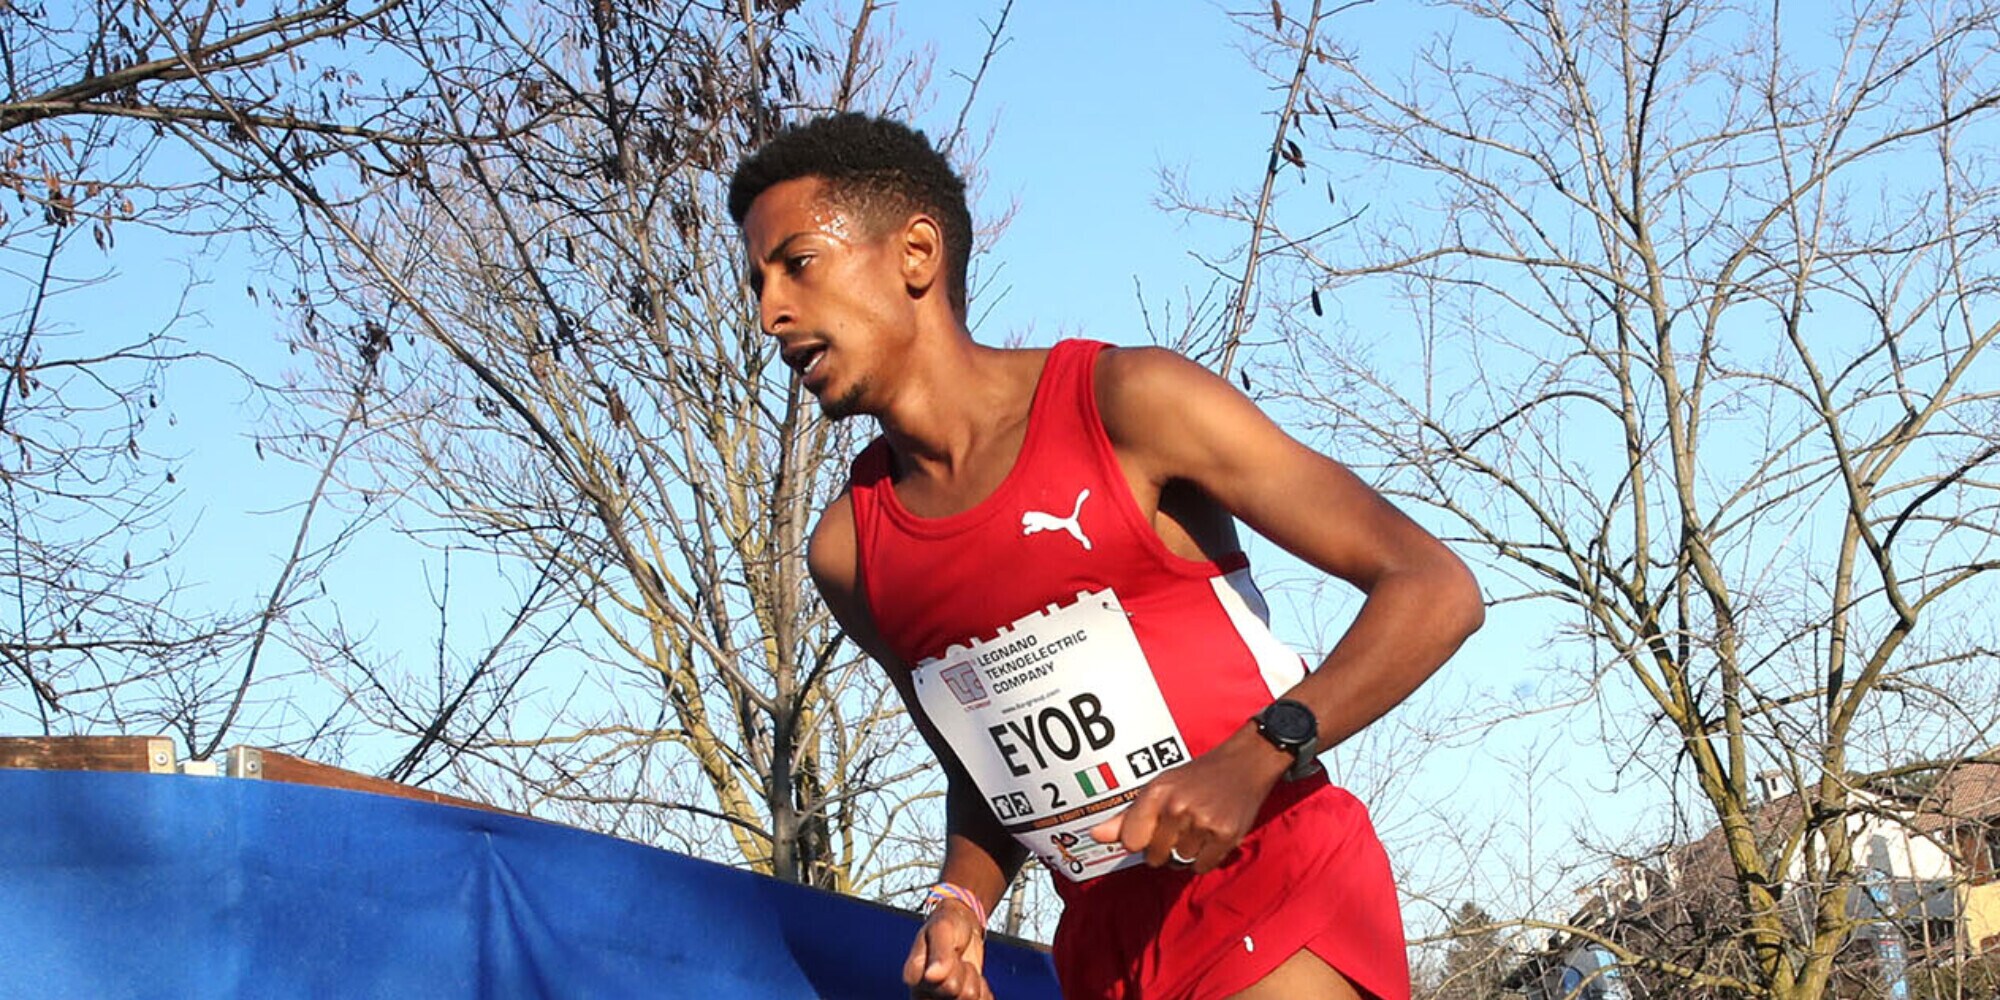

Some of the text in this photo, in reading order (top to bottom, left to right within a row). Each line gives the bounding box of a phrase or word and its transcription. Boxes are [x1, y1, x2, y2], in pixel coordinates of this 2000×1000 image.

[976, 634, 1038, 667] LEGNANO
[984, 629, 1088, 681] TEKNOELECTRIC
[992, 660, 1056, 695] COMPANY
[988, 692, 1116, 778] EYOB
[1041, 782, 1067, 809] 2
